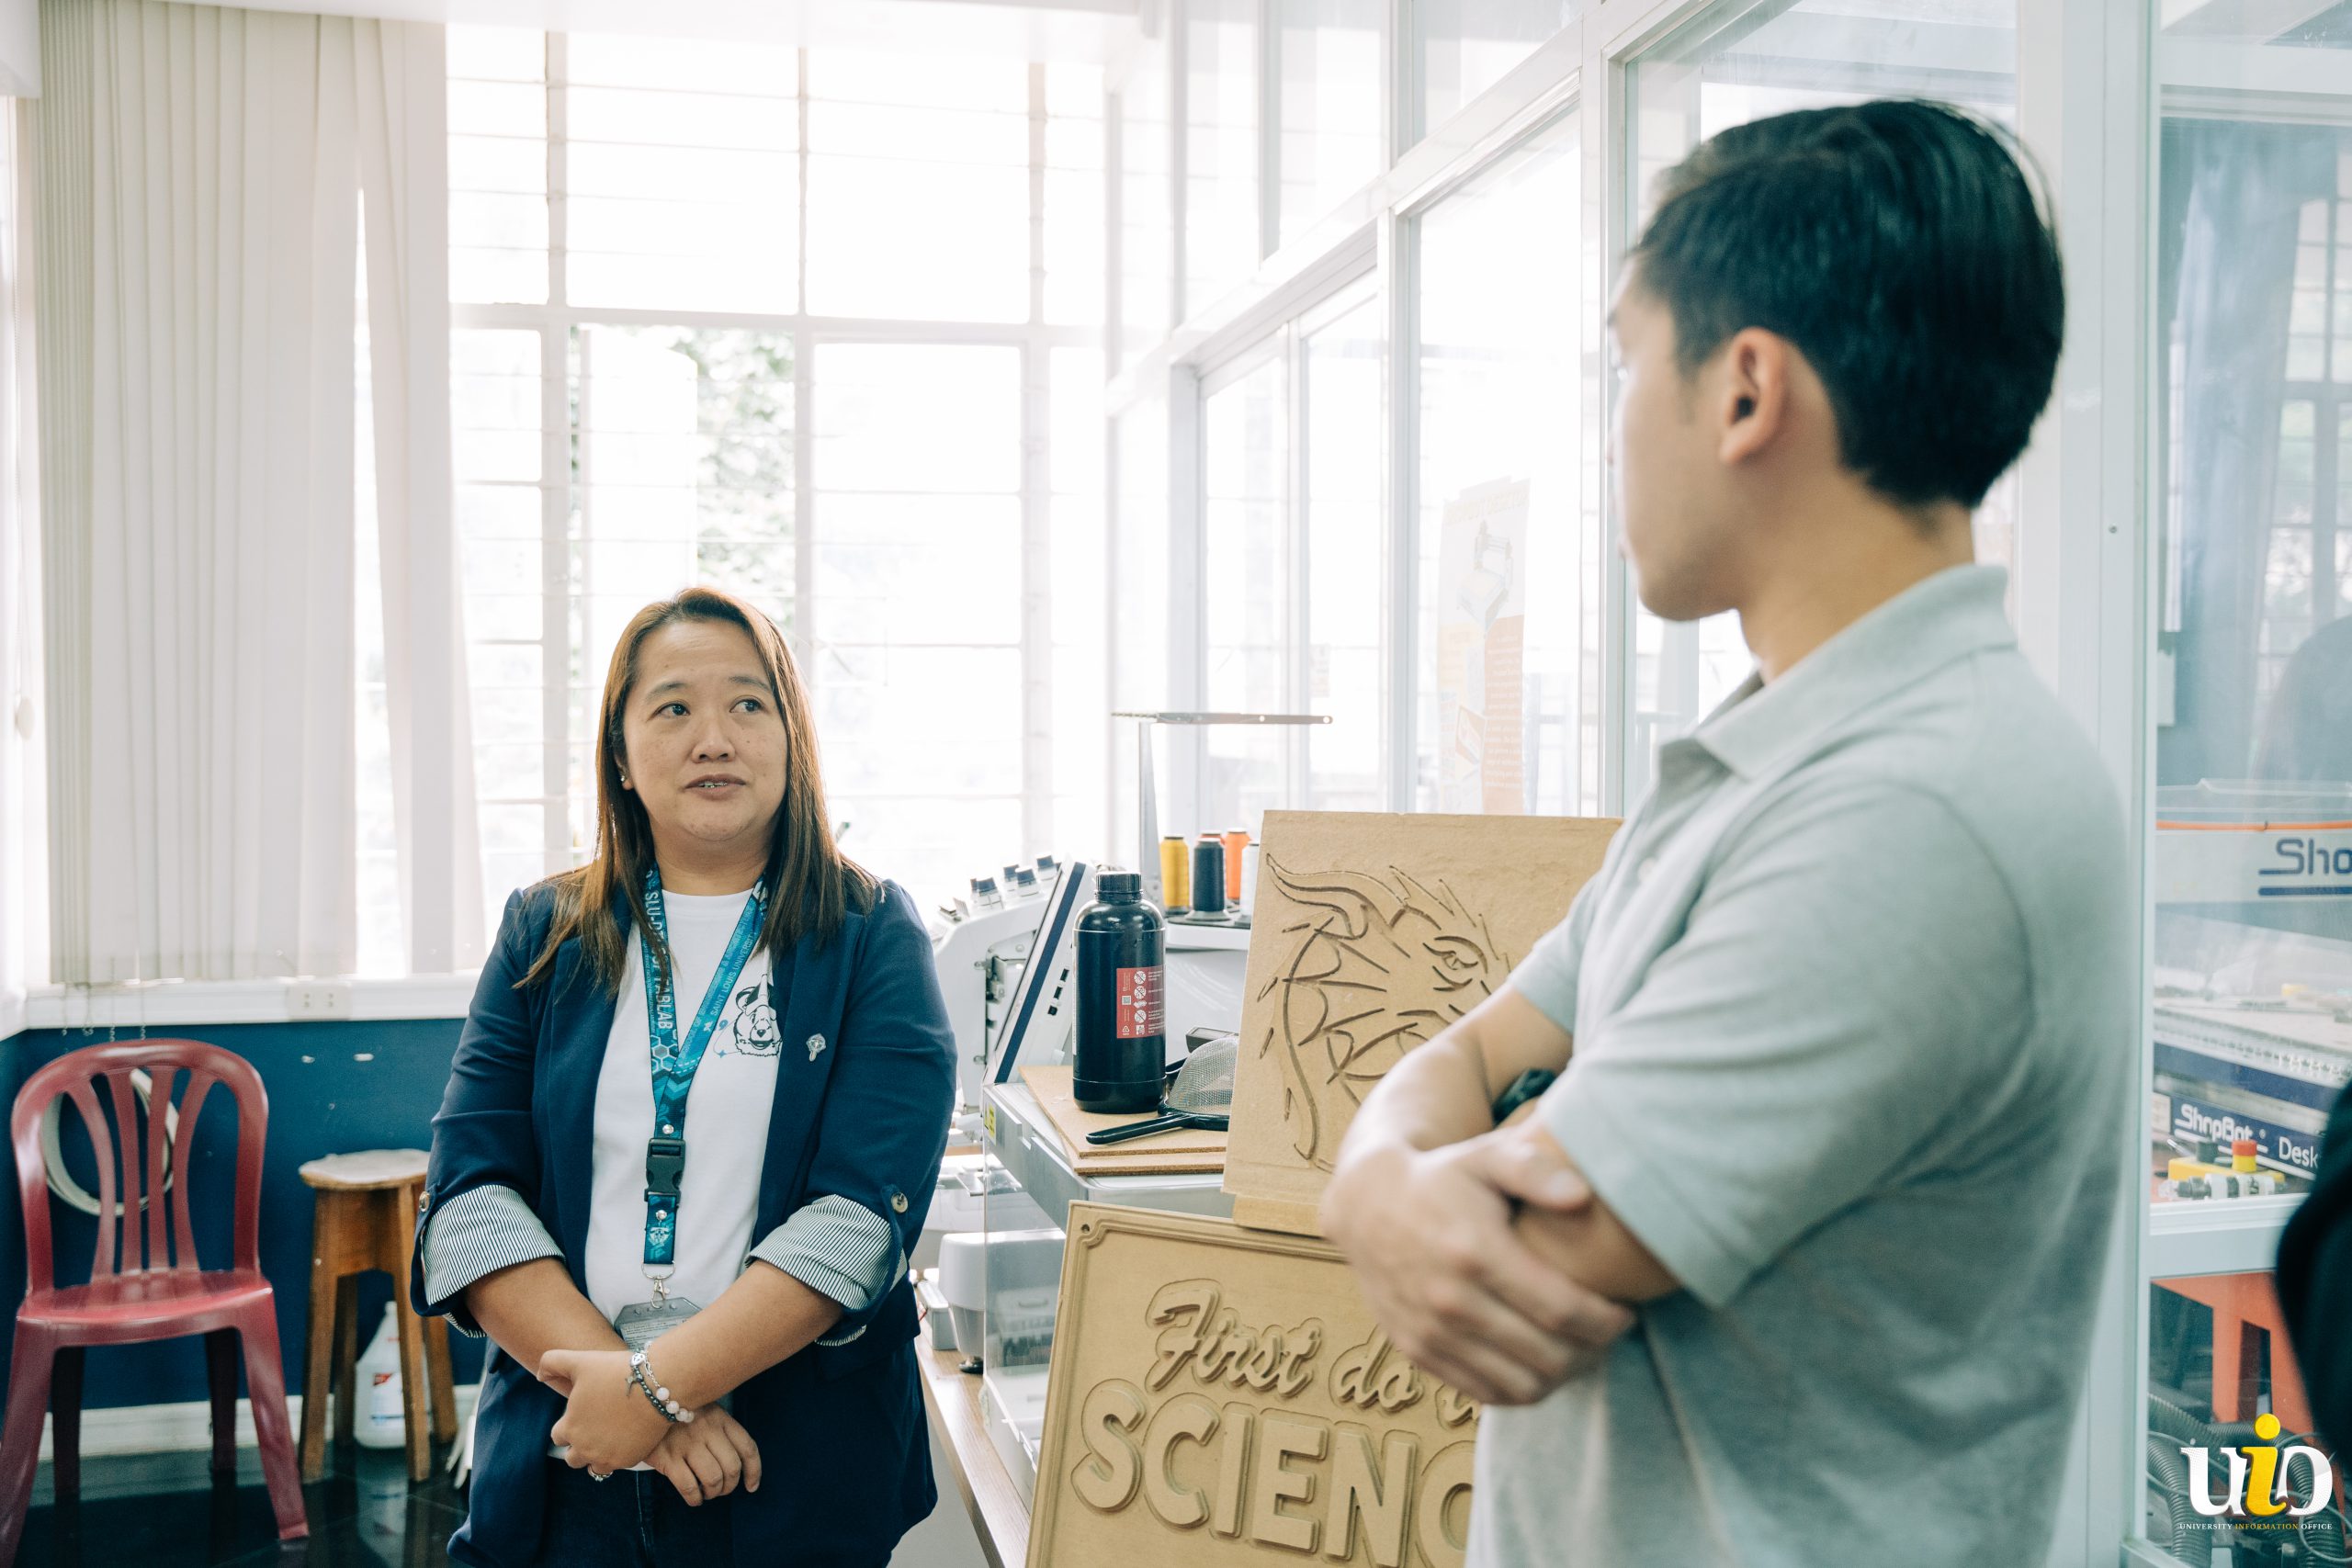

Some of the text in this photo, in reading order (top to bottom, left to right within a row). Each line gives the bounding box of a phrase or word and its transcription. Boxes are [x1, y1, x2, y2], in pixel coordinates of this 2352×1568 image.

[710, 993, 727, 1016] SAINT
[722, 972, 737, 993] LOUIS
[2174, 1103, 2319, 1168] ShopBot Desk
[1151, 1288, 1321, 1398] First
